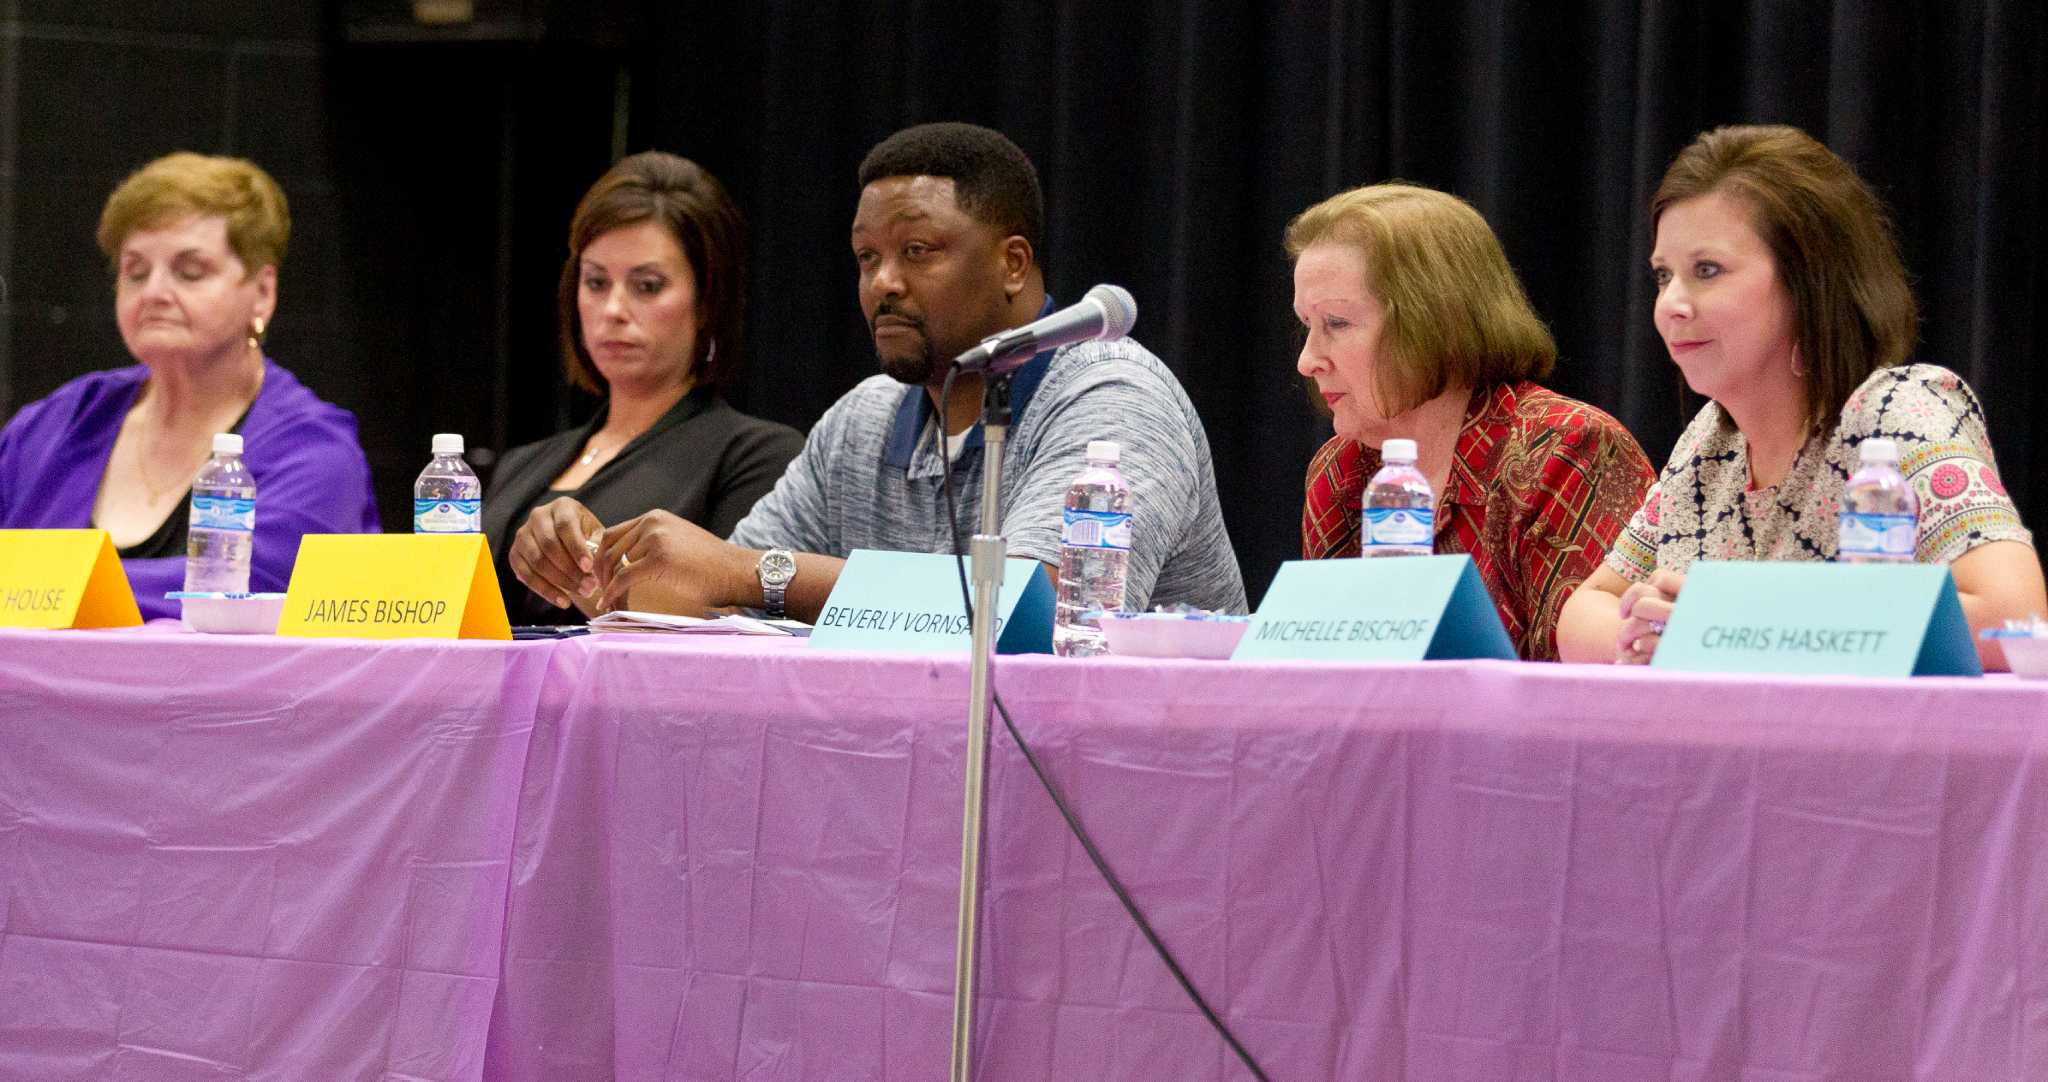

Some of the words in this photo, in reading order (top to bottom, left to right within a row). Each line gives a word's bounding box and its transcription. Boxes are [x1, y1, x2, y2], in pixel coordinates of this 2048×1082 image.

[5, 587, 64, 611] HOUSE
[305, 599, 369, 624] JAMES
[374, 600, 446, 625] BISHOP
[823, 606, 901, 631] BEVERLY
[903, 613, 1003, 635] VORNSAD
[1256, 620, 1348, 641] MICHELLE
[1346, 620, 1429, 642] BISCHOF
[1701, 625, 1774, 651] CHRIS
[1776, 628, 1888, 654] HASKETT
